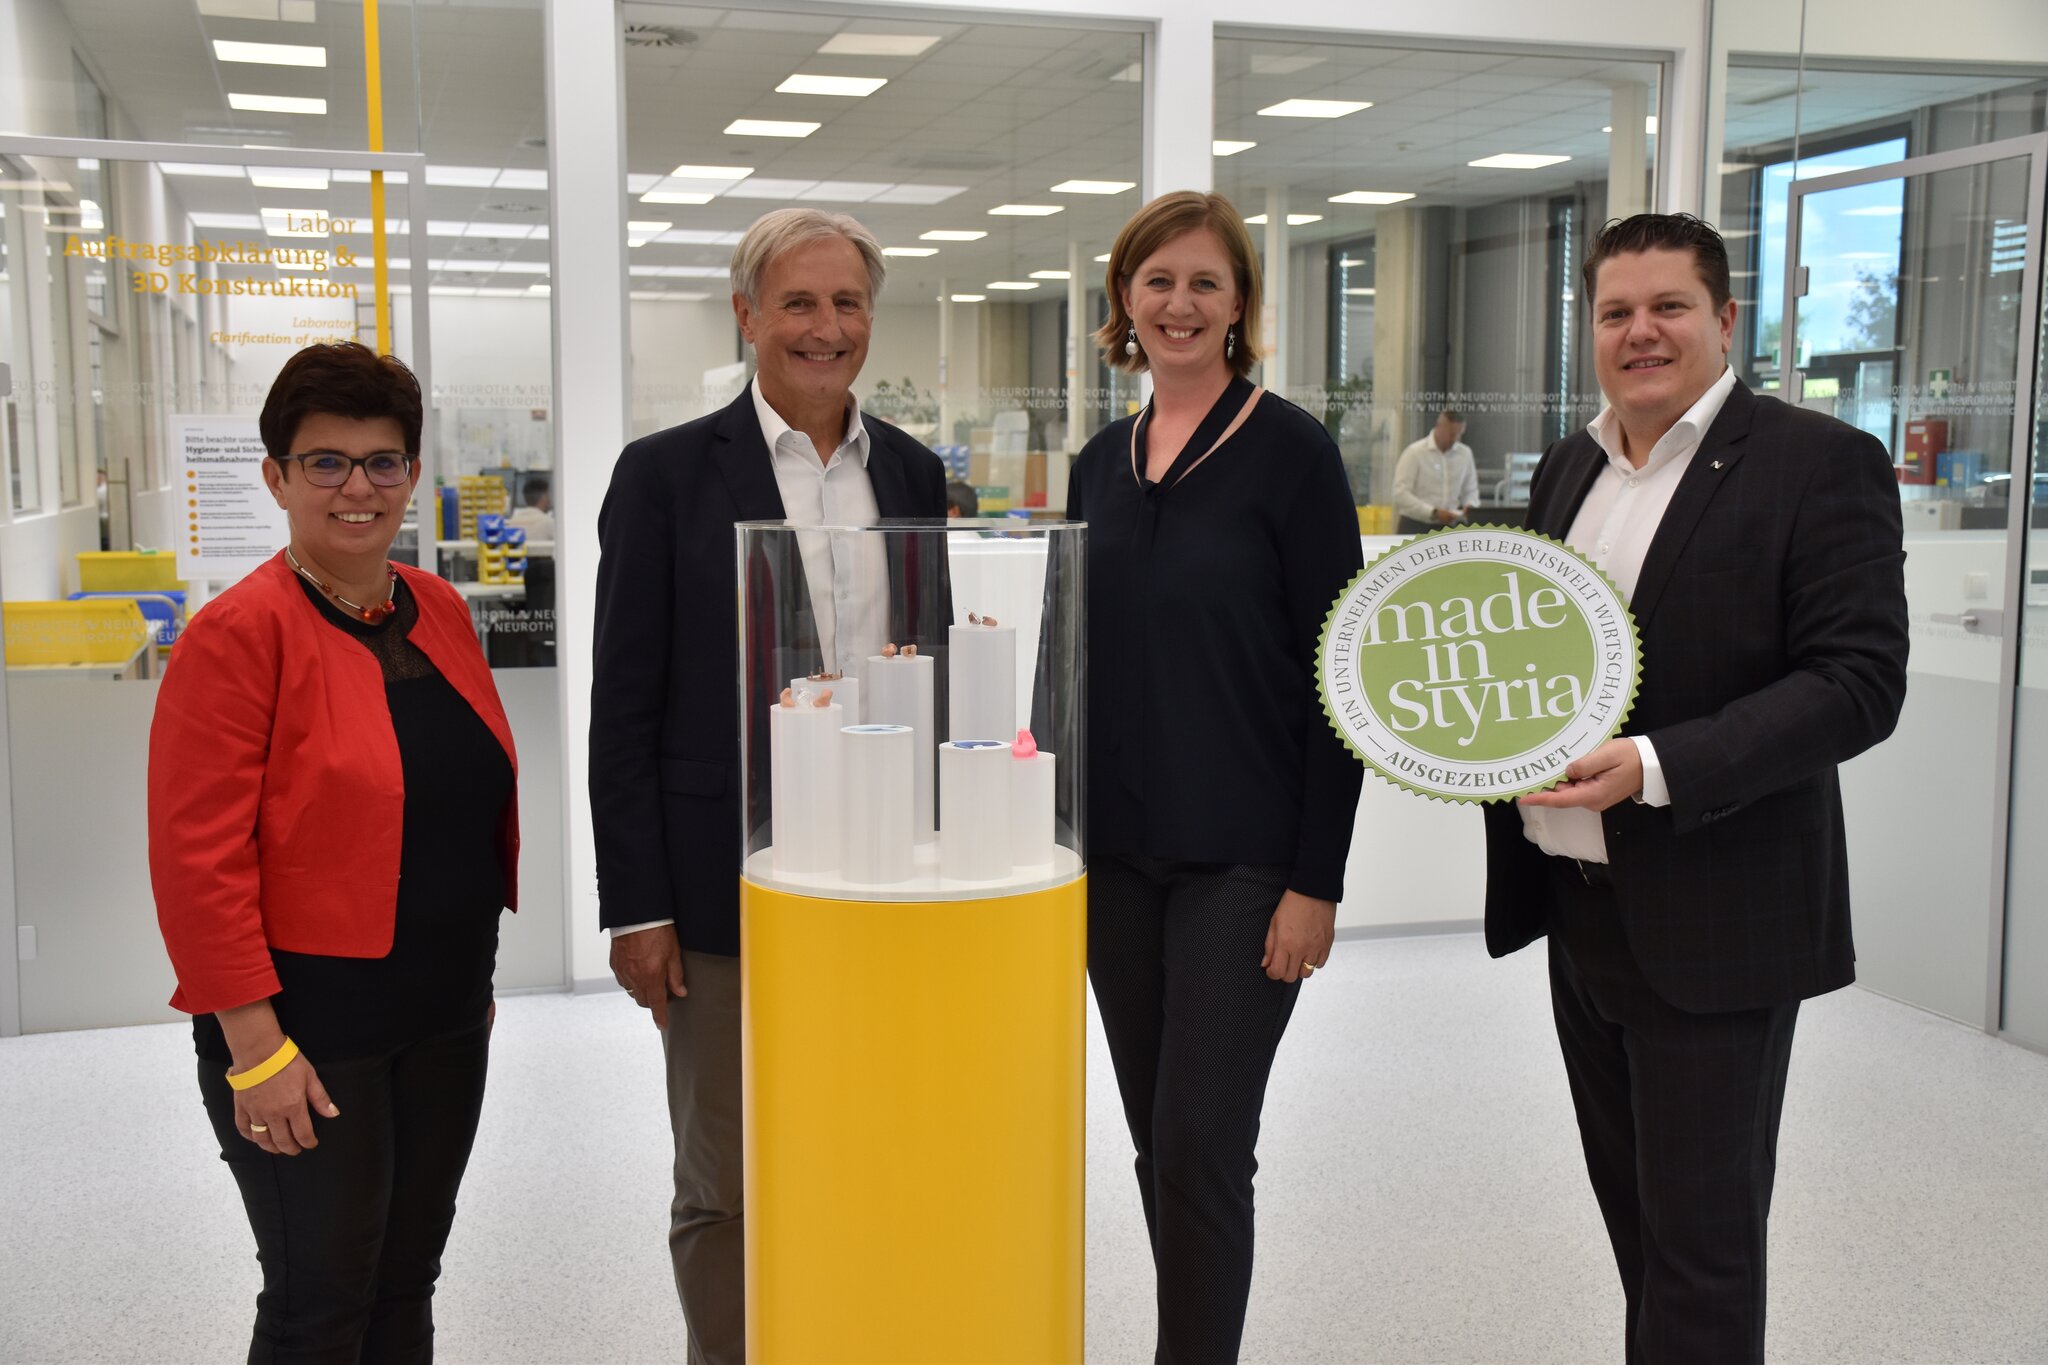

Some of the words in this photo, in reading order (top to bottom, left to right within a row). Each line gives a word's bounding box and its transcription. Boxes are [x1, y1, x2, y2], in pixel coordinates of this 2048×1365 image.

[287, 213, 357, 235] Labor
[63, 235, 329, 272] Auftragsabklärung
[335, 245, 358, 267] &
[132, 272, 169, 294] 3D
[178, 272, 359, 299] Konstruktion
[292, 317, 360, 332] Laboratory
[210, 332, 292, 346] Clarification
[295, 333, 309, 346] of
[992, 387, 1044, 398] NEUROTH
[1460, 391, 1506, 402] NEUROTH
[1428, 402, 1475, 413] NEUROTH
[1490, 403, 1537, 413] NEUROTH
[185, 435, 204, 444] Bitte
[206, 435, 236, 444] beachte
[186, 446, 221, 455] Hygiene-
[1410, 542, 1452, 567] DER
[1458, 538, 1602, 602] ERLEBNISWELT
[1362, 571, 1568, 647] made
[494, 621, 554, 633] NEUROTH
[1333, 562, 1407, 695] UNTERNEHMEN
[1421, 639, 1495, 685] in
[1593, 603, 1622, 726] WIRTSCHAFT
[1341, 699, 1369, 732] EIN
[1388, 663, 1583, 747] styria
[1385, 744, 1572, 788] AUSGEZEICHNET
